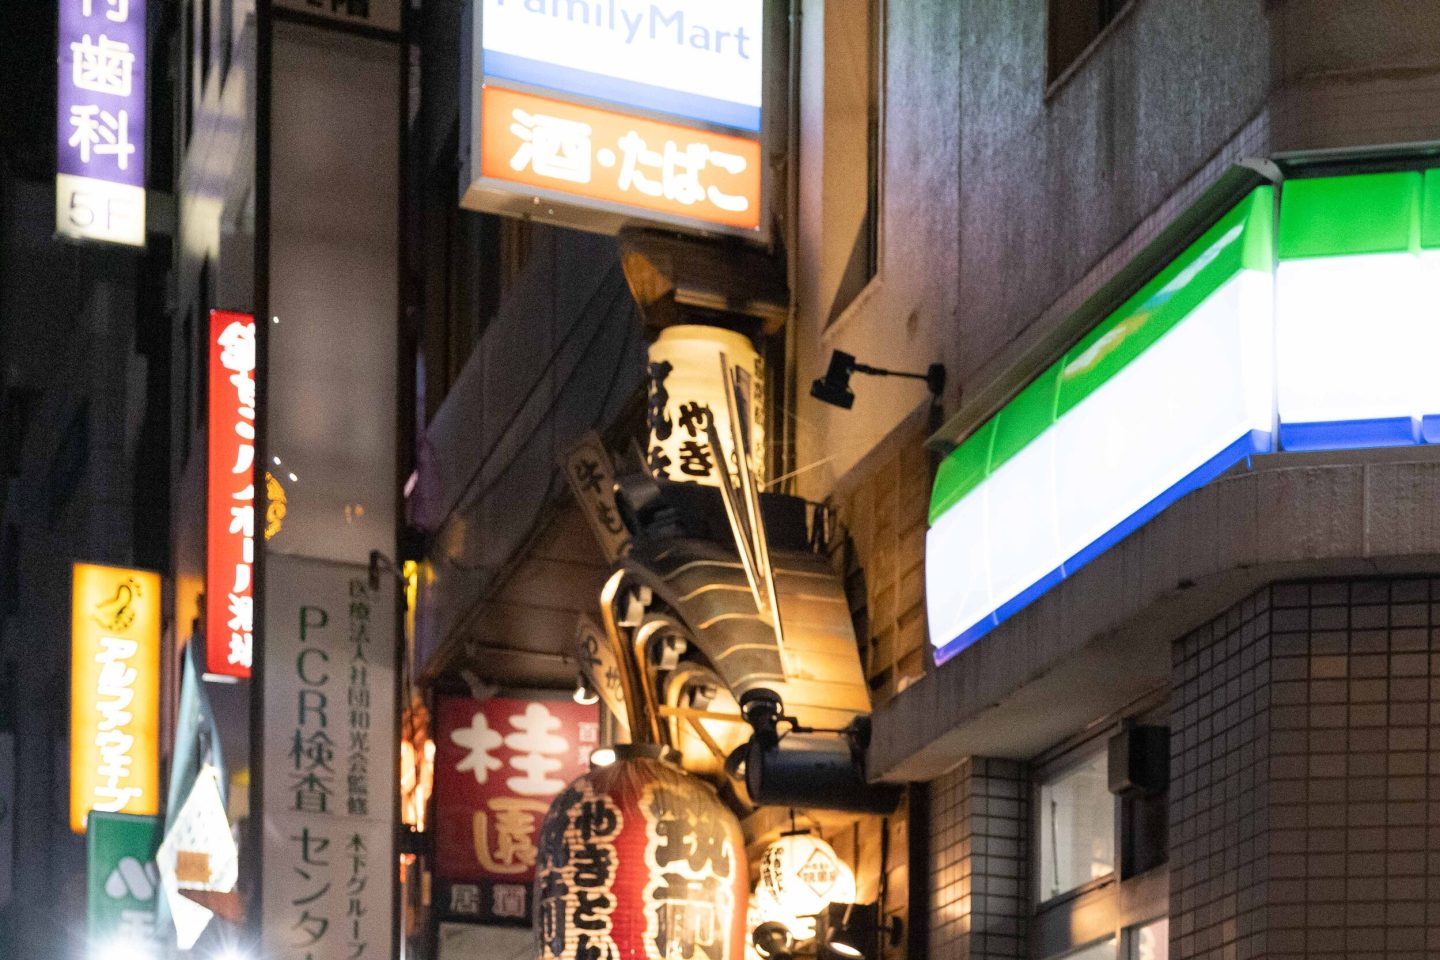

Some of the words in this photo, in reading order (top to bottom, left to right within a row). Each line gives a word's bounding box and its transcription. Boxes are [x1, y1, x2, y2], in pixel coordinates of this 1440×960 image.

[497, 0, 751, 60] amilyMart
[68, 0, 136, 171] 歯科
[509, 107, 749, 212] 酒・たばこ
